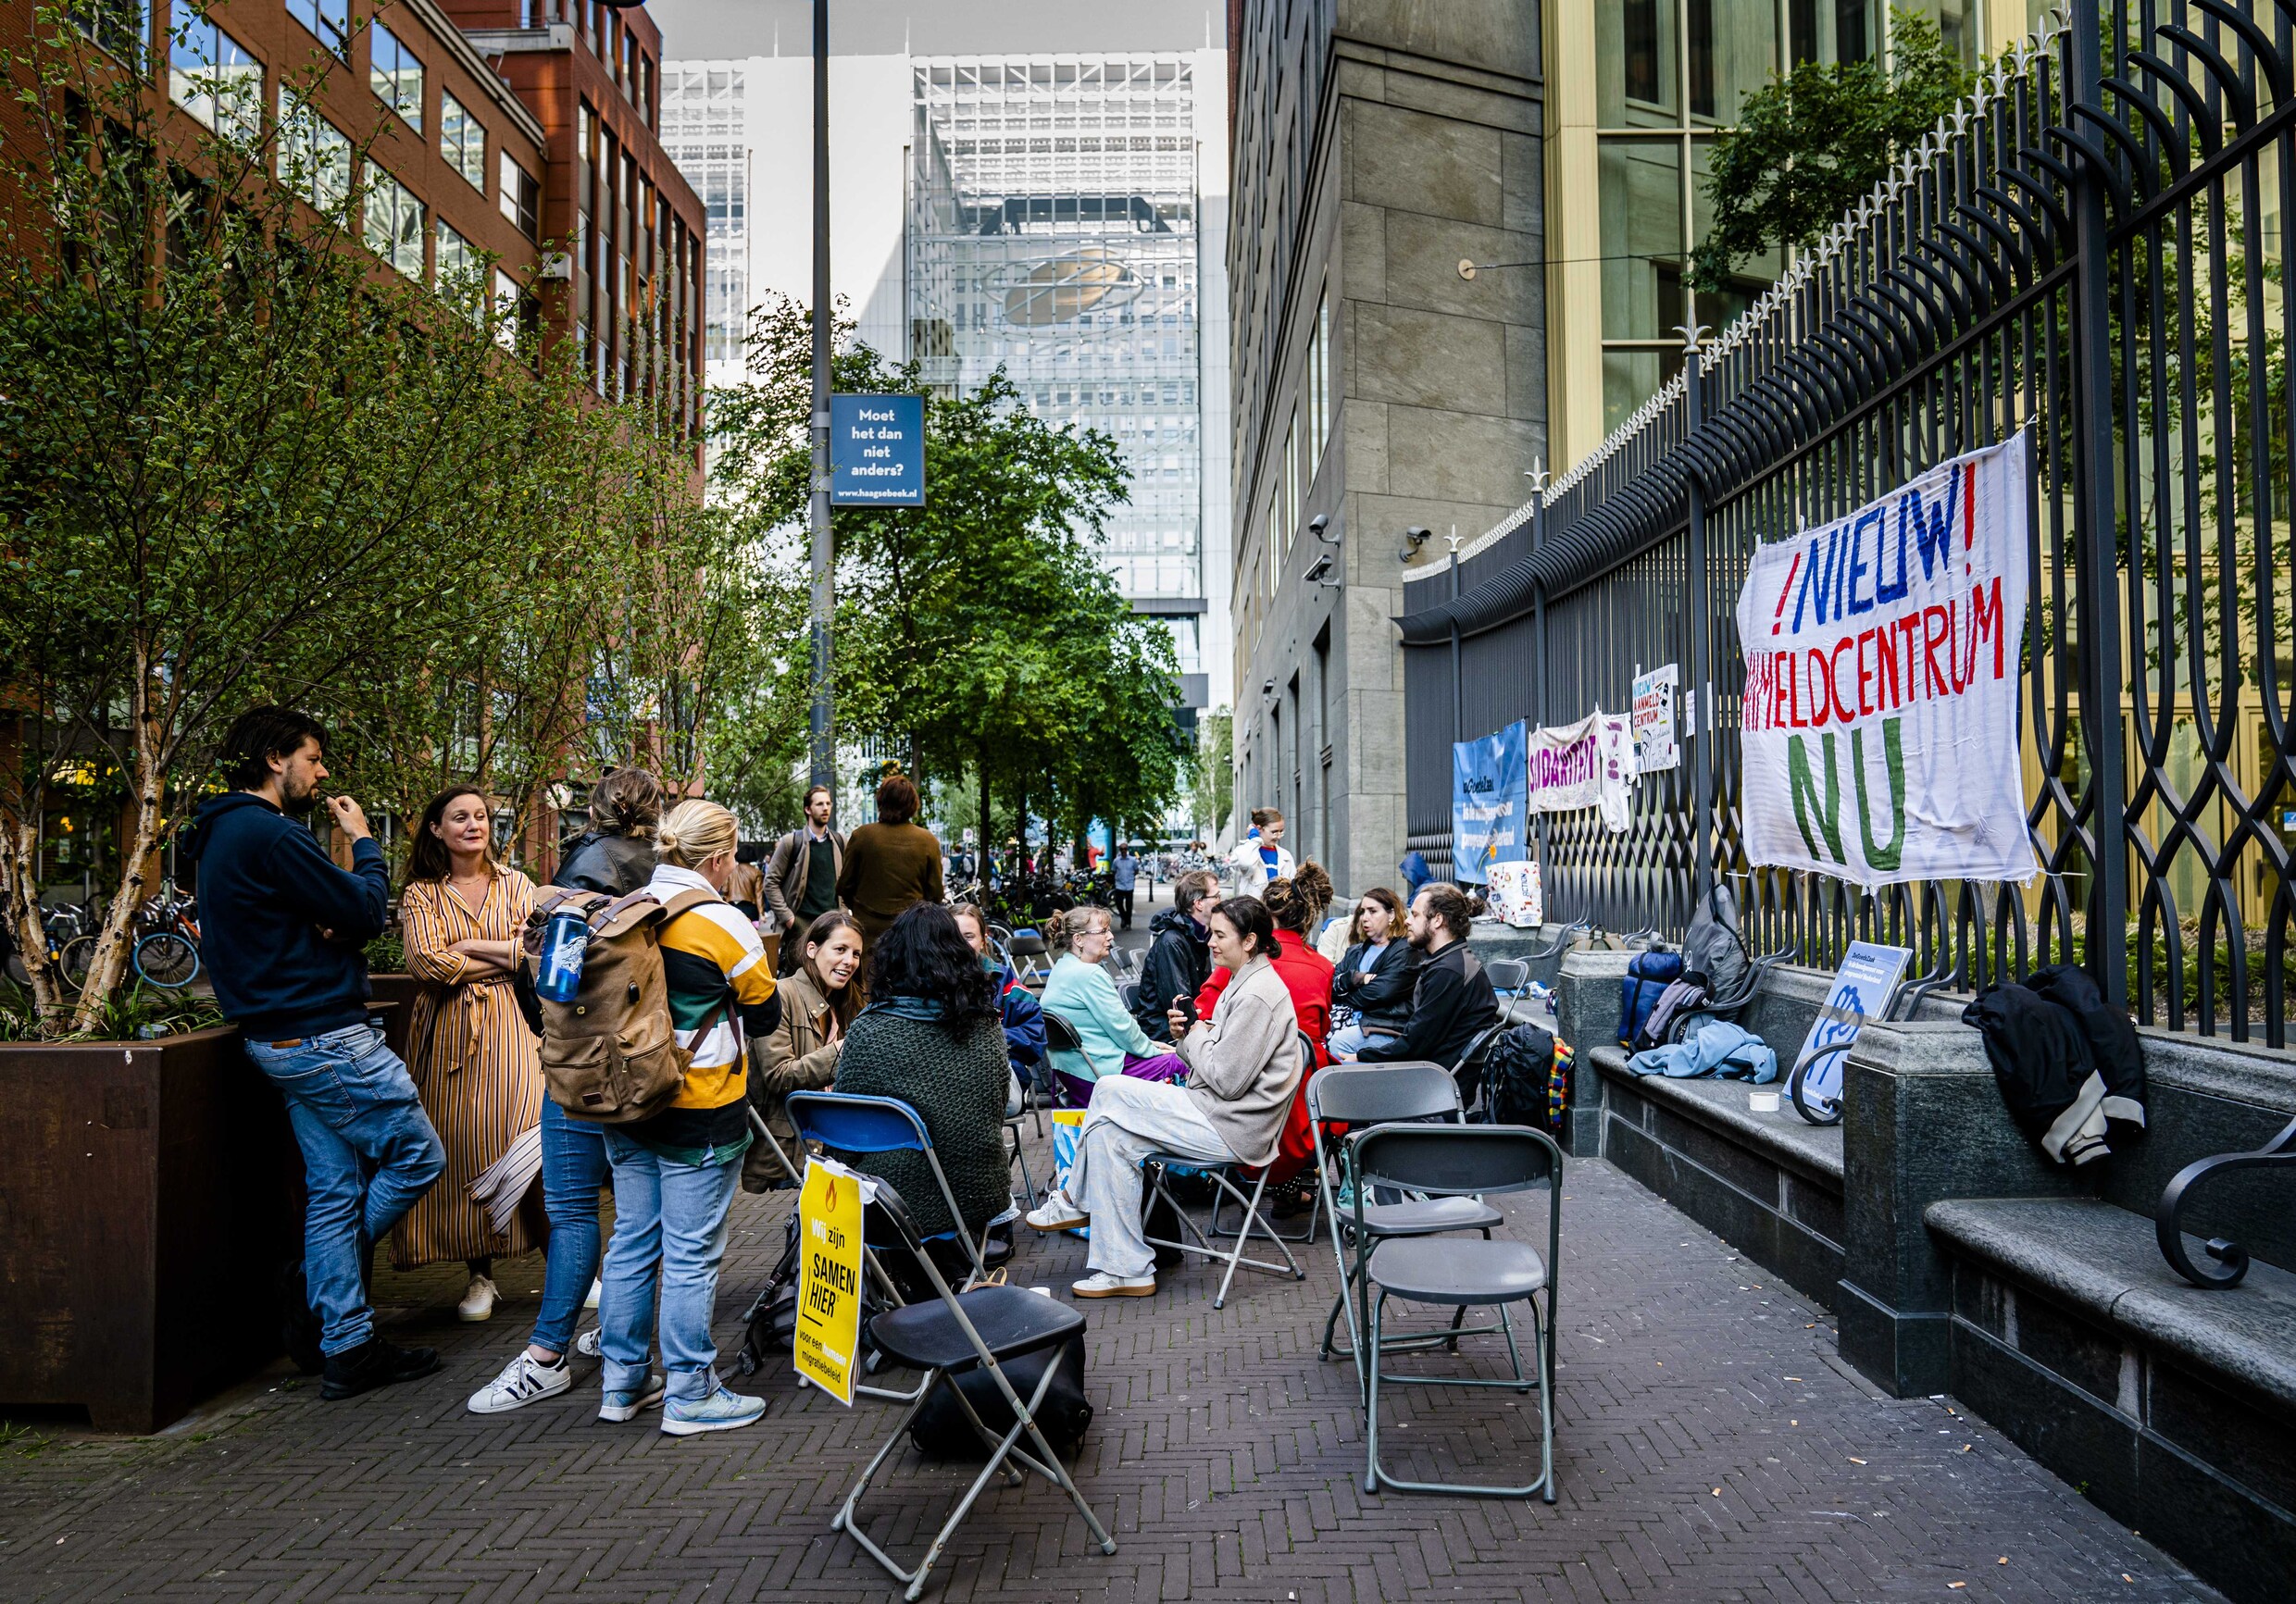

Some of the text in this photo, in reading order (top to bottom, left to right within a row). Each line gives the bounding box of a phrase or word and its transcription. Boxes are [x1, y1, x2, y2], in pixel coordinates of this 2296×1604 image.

[859, 409, 895, 421] Moet
[852, 427, 903, 440] het dan
[863, 445, 891, 457] niet
[851, 463, 904, 476] anders?
[838, 489, 917, 499] www.haagsebeek.nl
[1634, 709, 1658, 728] CENTRUM
[1788, 717, 1906, 872] NU
[811, 1217, 844, 1250] Wij zijn
[813, 1252, 855, 1296] SAMEN
[799, 1329, 847, 1367] voor een humaan
[802, 1350, 842, 1384] migratiebeleid
